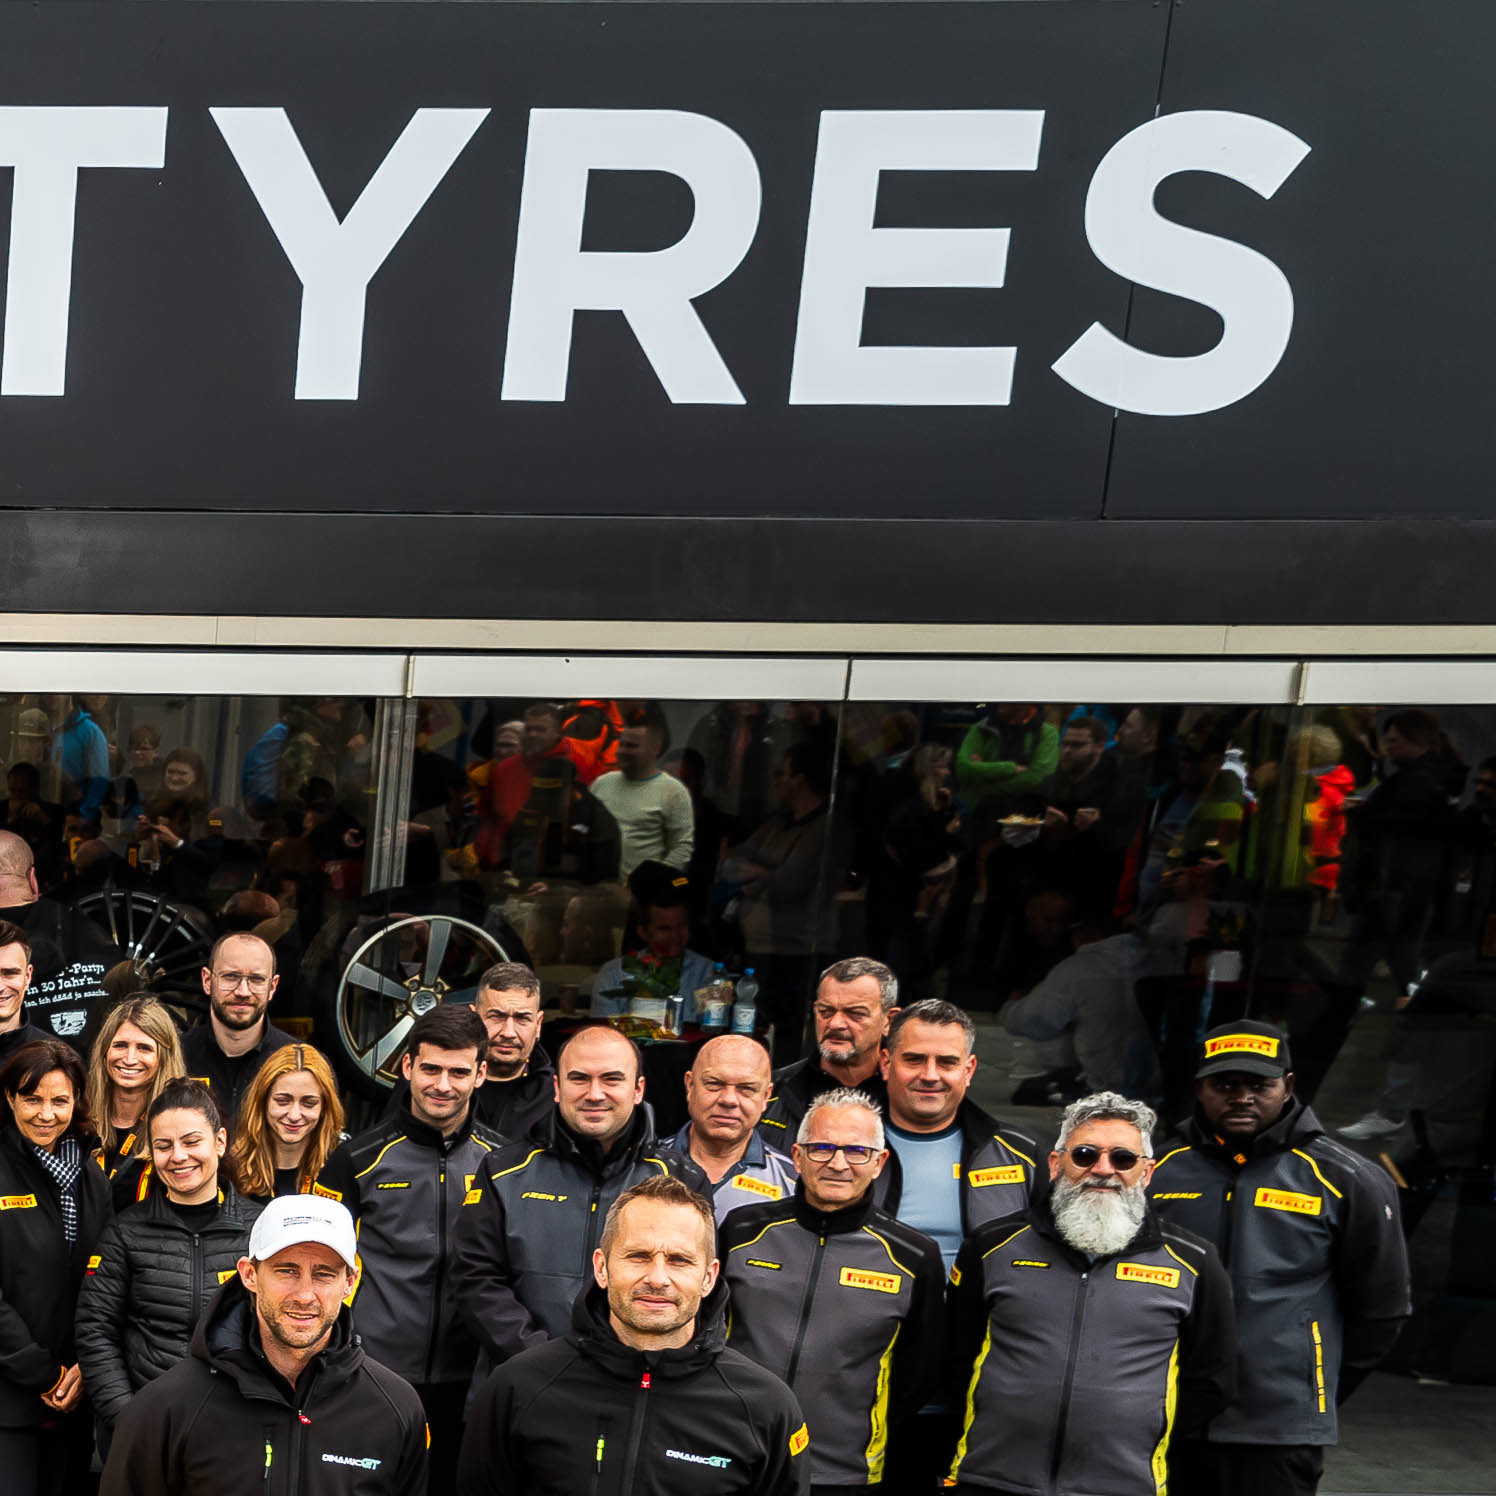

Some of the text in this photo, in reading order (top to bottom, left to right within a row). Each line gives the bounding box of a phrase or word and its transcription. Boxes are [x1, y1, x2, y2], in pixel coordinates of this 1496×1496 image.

[41, 981, 56, 992] 30
[1210, 1036, 1272, 1054] PIRELLI
[972, 1169, 1018, 1184] PIRELLI
[1261, 1193, 1314, 1211] PIRELLI
[846, 1271, 895, 1290] PIRELLI
[1122, 1267, 1174, 1284] PIRELLI
